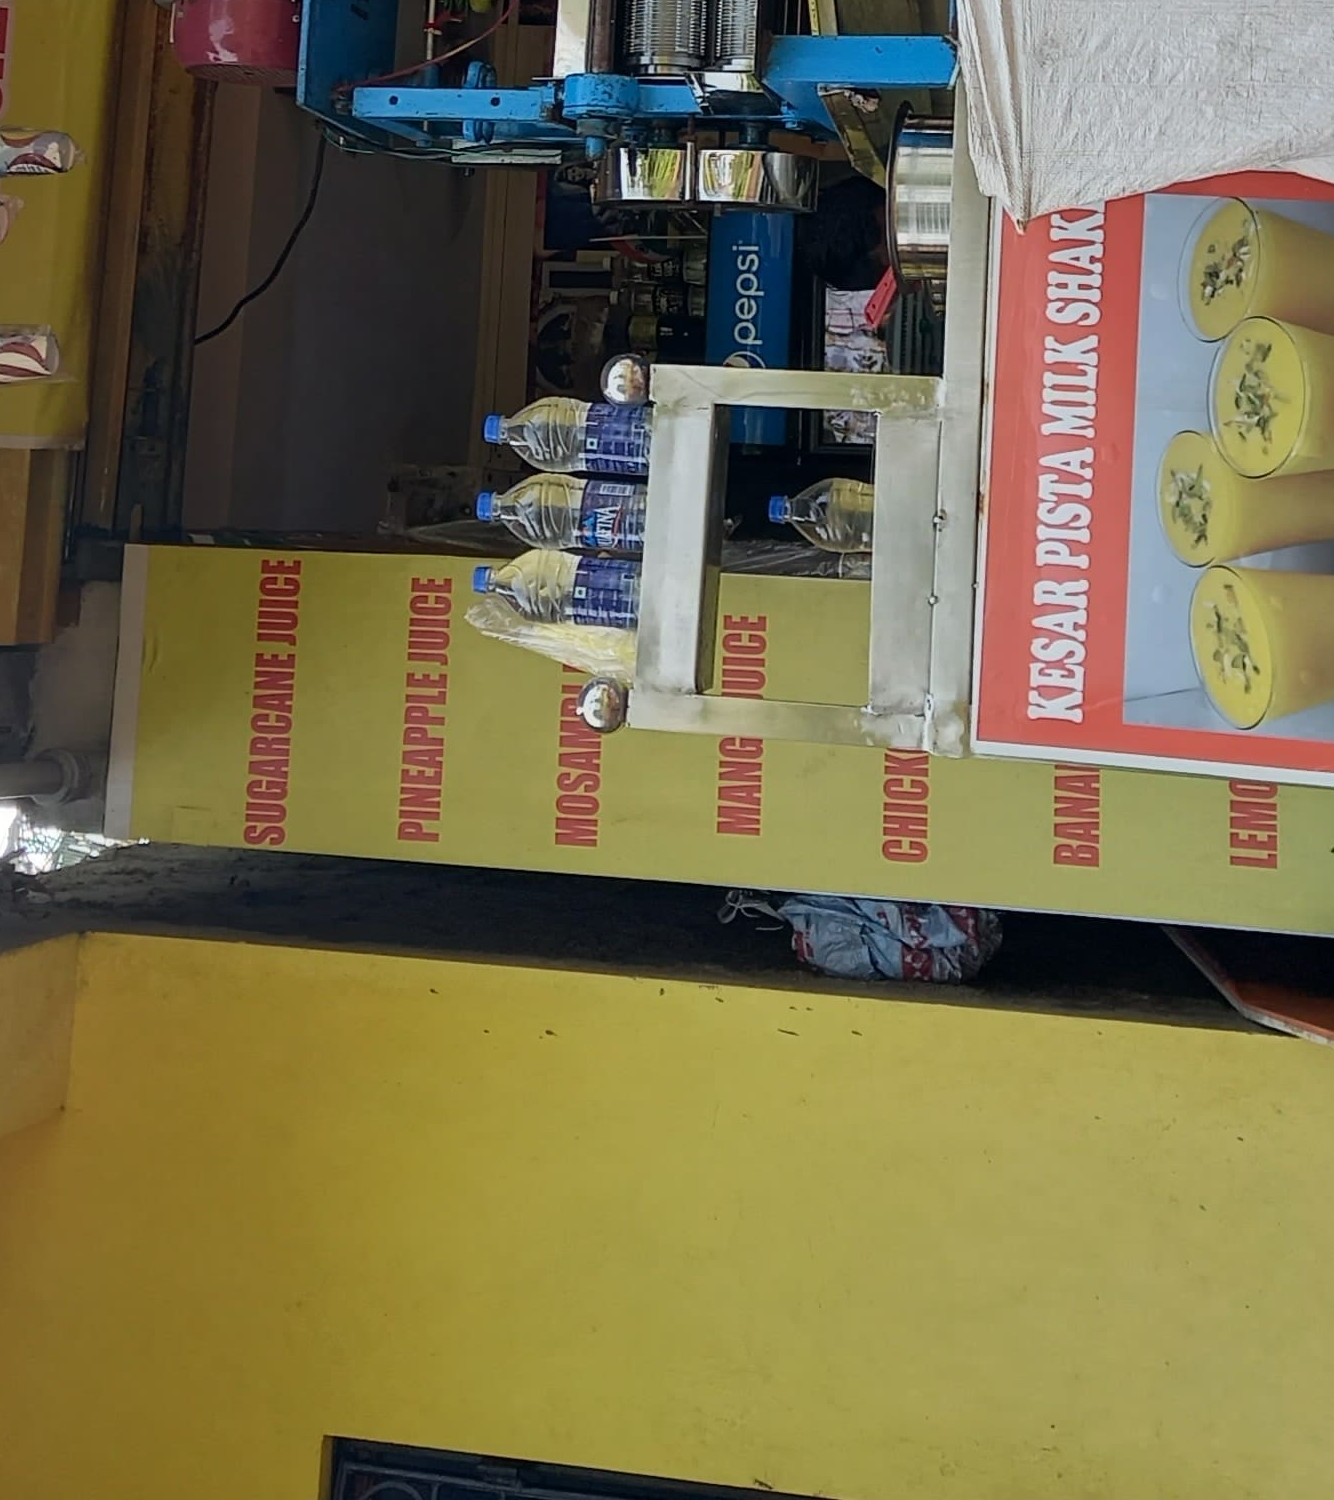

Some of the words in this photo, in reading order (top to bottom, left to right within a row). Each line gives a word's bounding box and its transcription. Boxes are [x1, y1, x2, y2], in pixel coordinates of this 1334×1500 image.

[731, 245, 765, 345] pepsi
[1042, 335, 1099, 439] MILK
[592, 503, 622, 547] UAFINA
[1034, 447, 1094, 570] PISTA
[256, 560, 301, 647] JUICE
[407, 577, 453, 666] JUICE
[1027, 579, 1089, 723] KESAR
[721, 614, 767, 699] JUICE
[243, 653, 297, 845] SUGARCANE
[398, 673, 448, 842] PINEAPPLE
[716, 737, 764, 836] MANG
[882, 749, 929, 864] CHICK
[1053, 764, 1101, 867] BANA
[1229, 780, 1277, 870] LEMO
